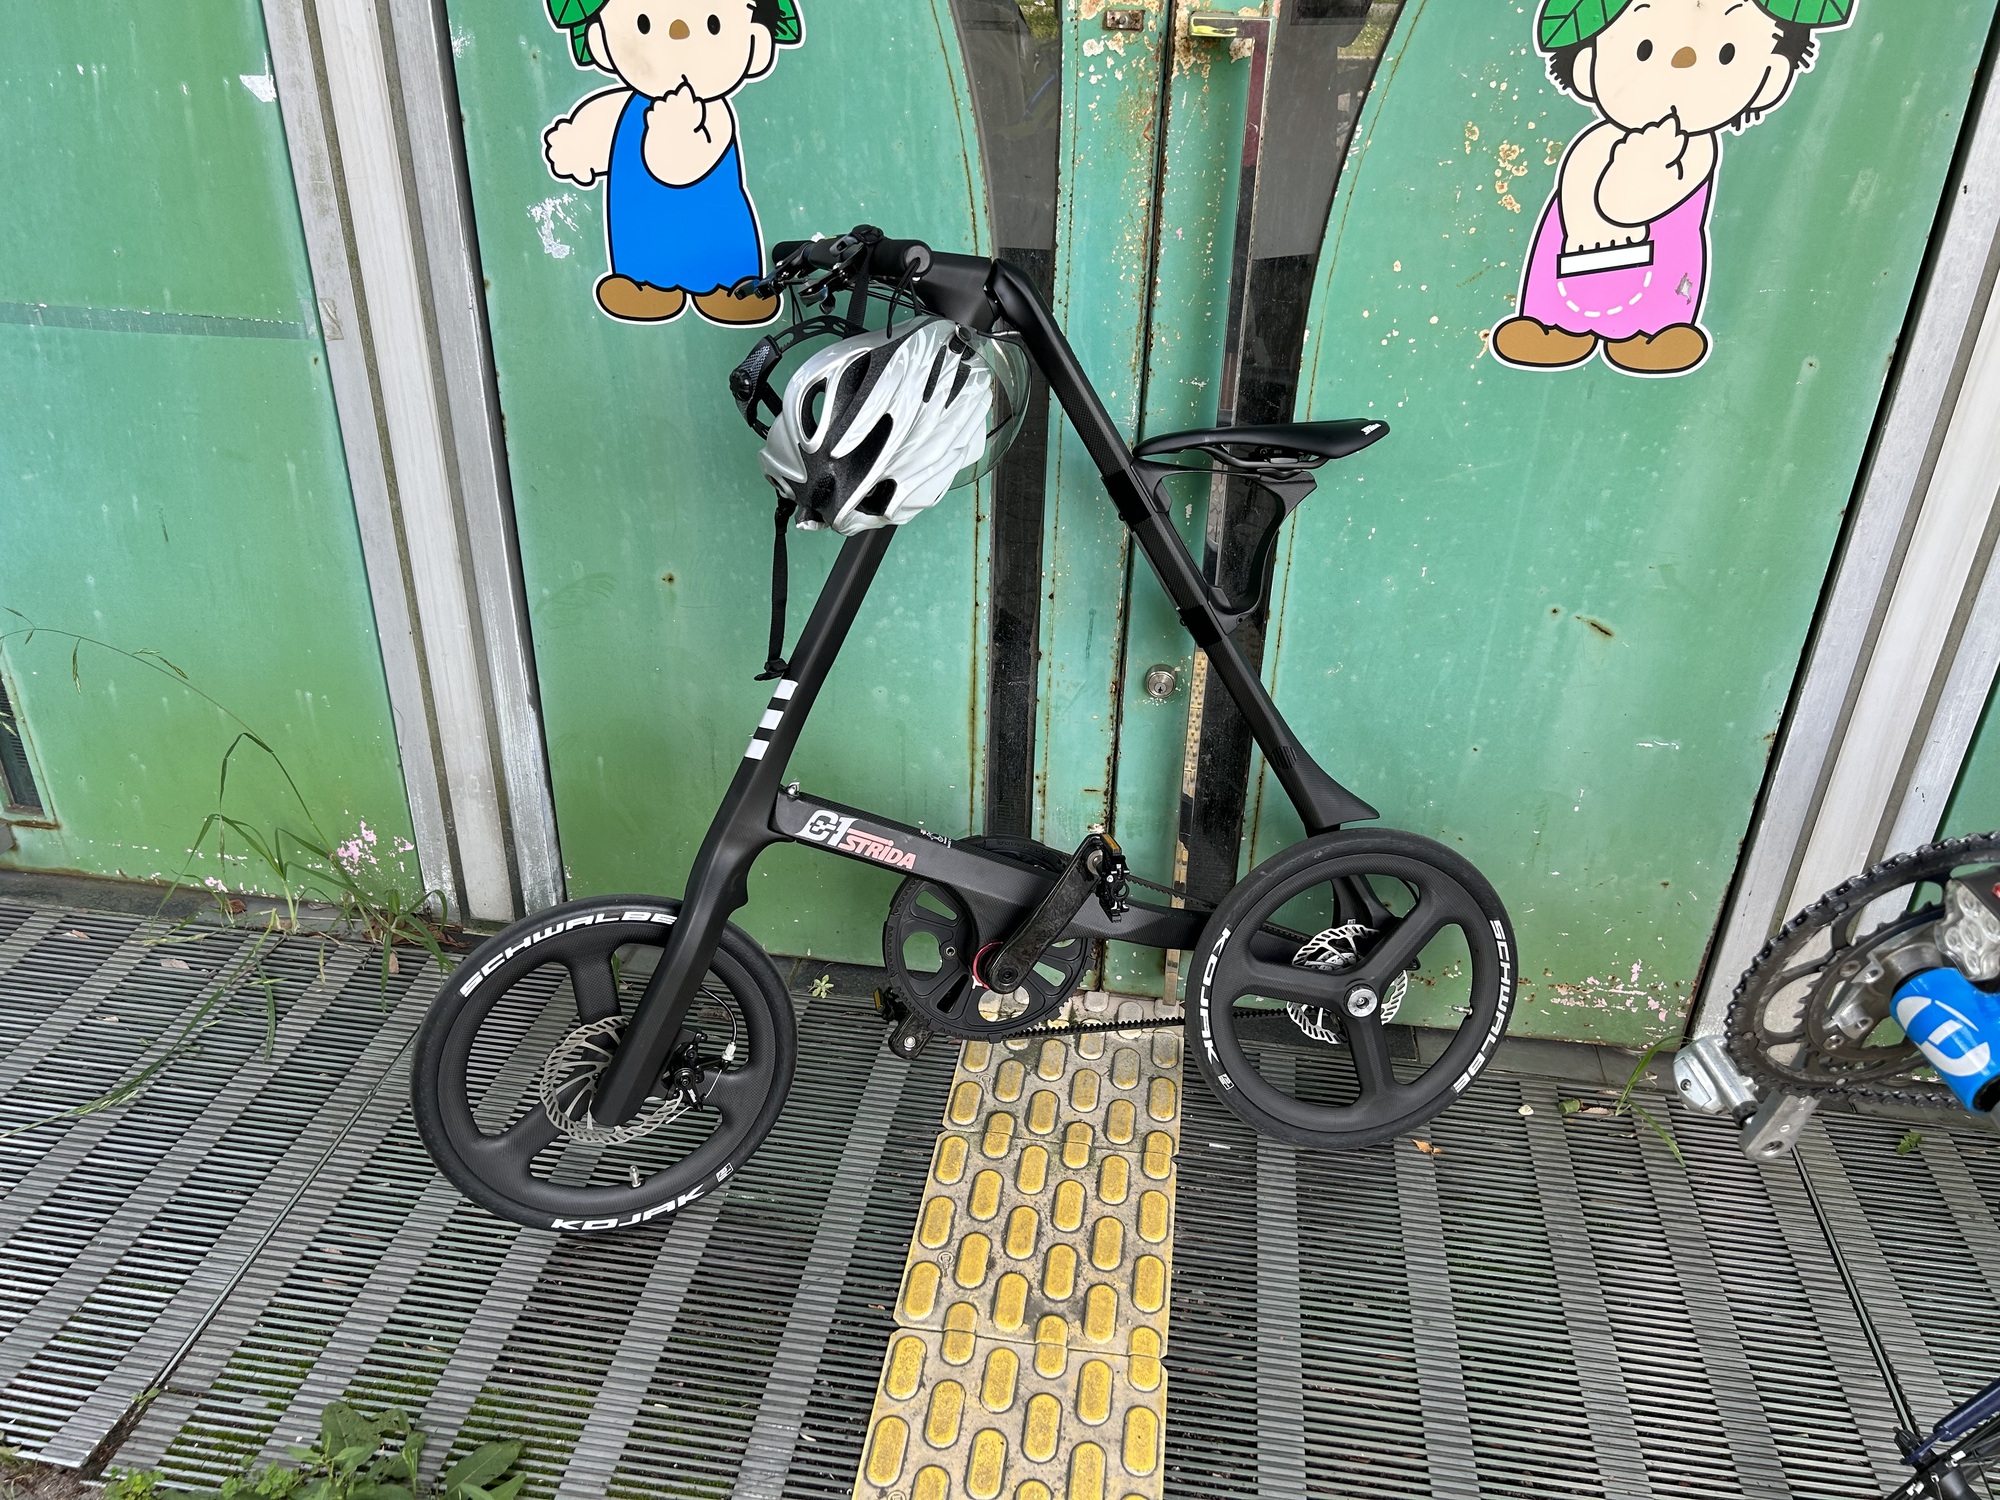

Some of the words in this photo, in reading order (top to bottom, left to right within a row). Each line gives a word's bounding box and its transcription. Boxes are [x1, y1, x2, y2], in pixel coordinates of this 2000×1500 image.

[460, 911, 678, 998] SCHWALBE
[1199, 927, 1231, 1065] KOJAK
[1452, 919, 1511, 1093] SCHWALBE
[551, 1184, 705, 1231] KOJAK
